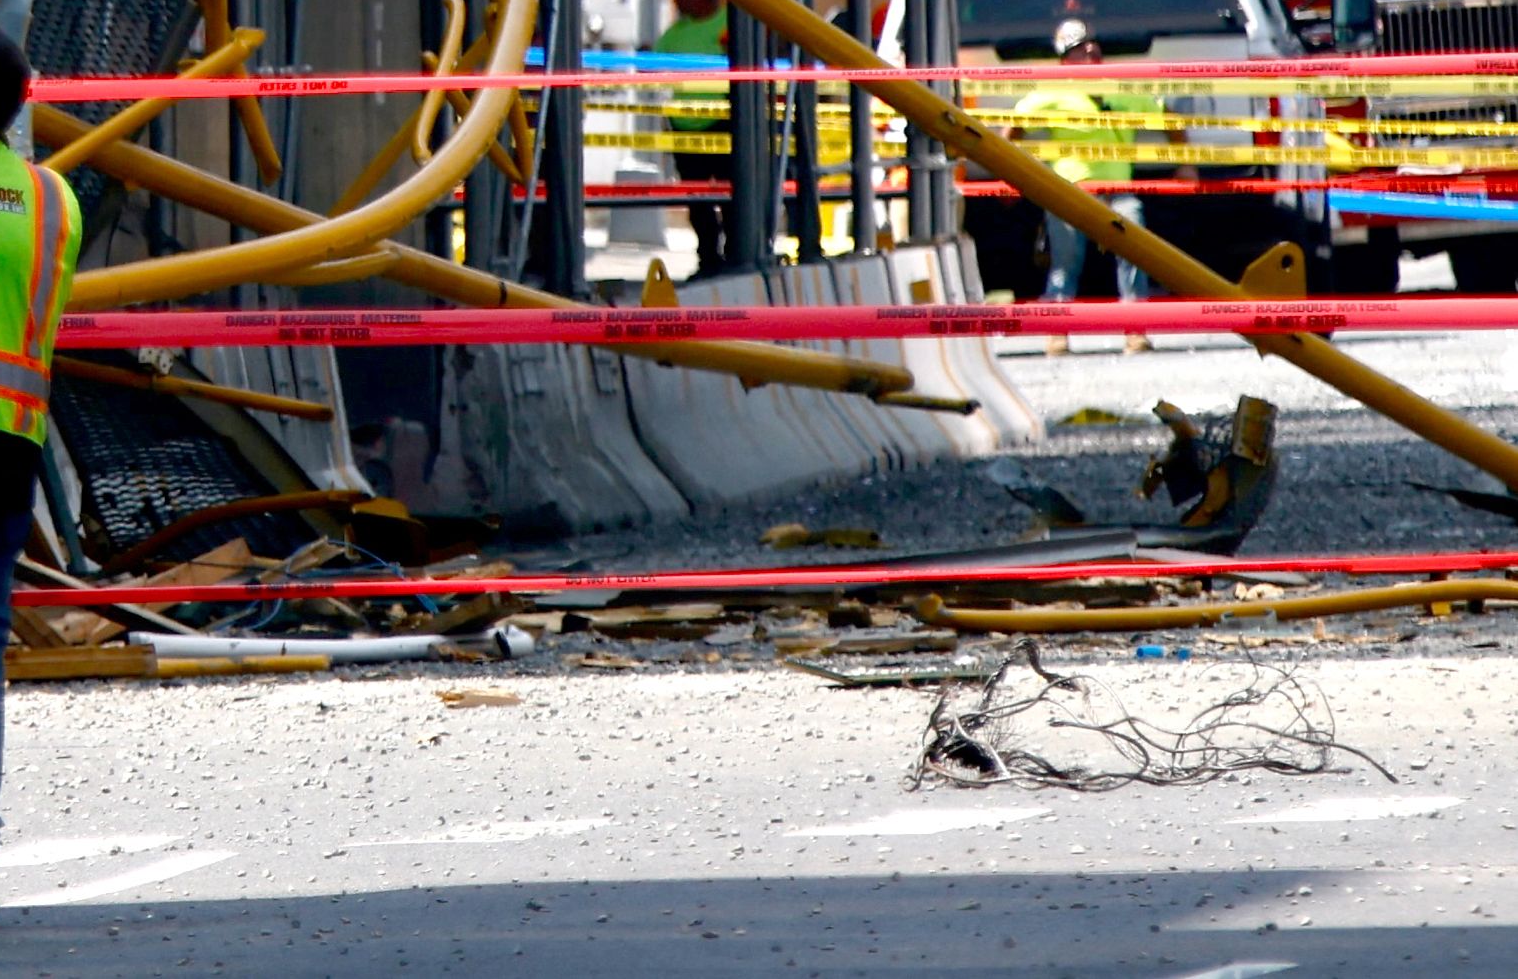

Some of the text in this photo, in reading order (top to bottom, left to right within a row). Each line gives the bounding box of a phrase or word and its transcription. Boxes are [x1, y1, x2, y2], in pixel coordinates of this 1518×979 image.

[877, 307, 1074, 319] DANGER HAZARDOUS MATERIAL
[1202, 303, 1399, 315] DANGER HAZARDOUS MATERIAL
[226, 314, 422, 326] DANGER HAZARDOUS MATERIAL
[551, 310, 750, 322] DANGER HAZARDOUS MATERIAL
[1254, 315, 1347, 327] DO NOT ENTER
